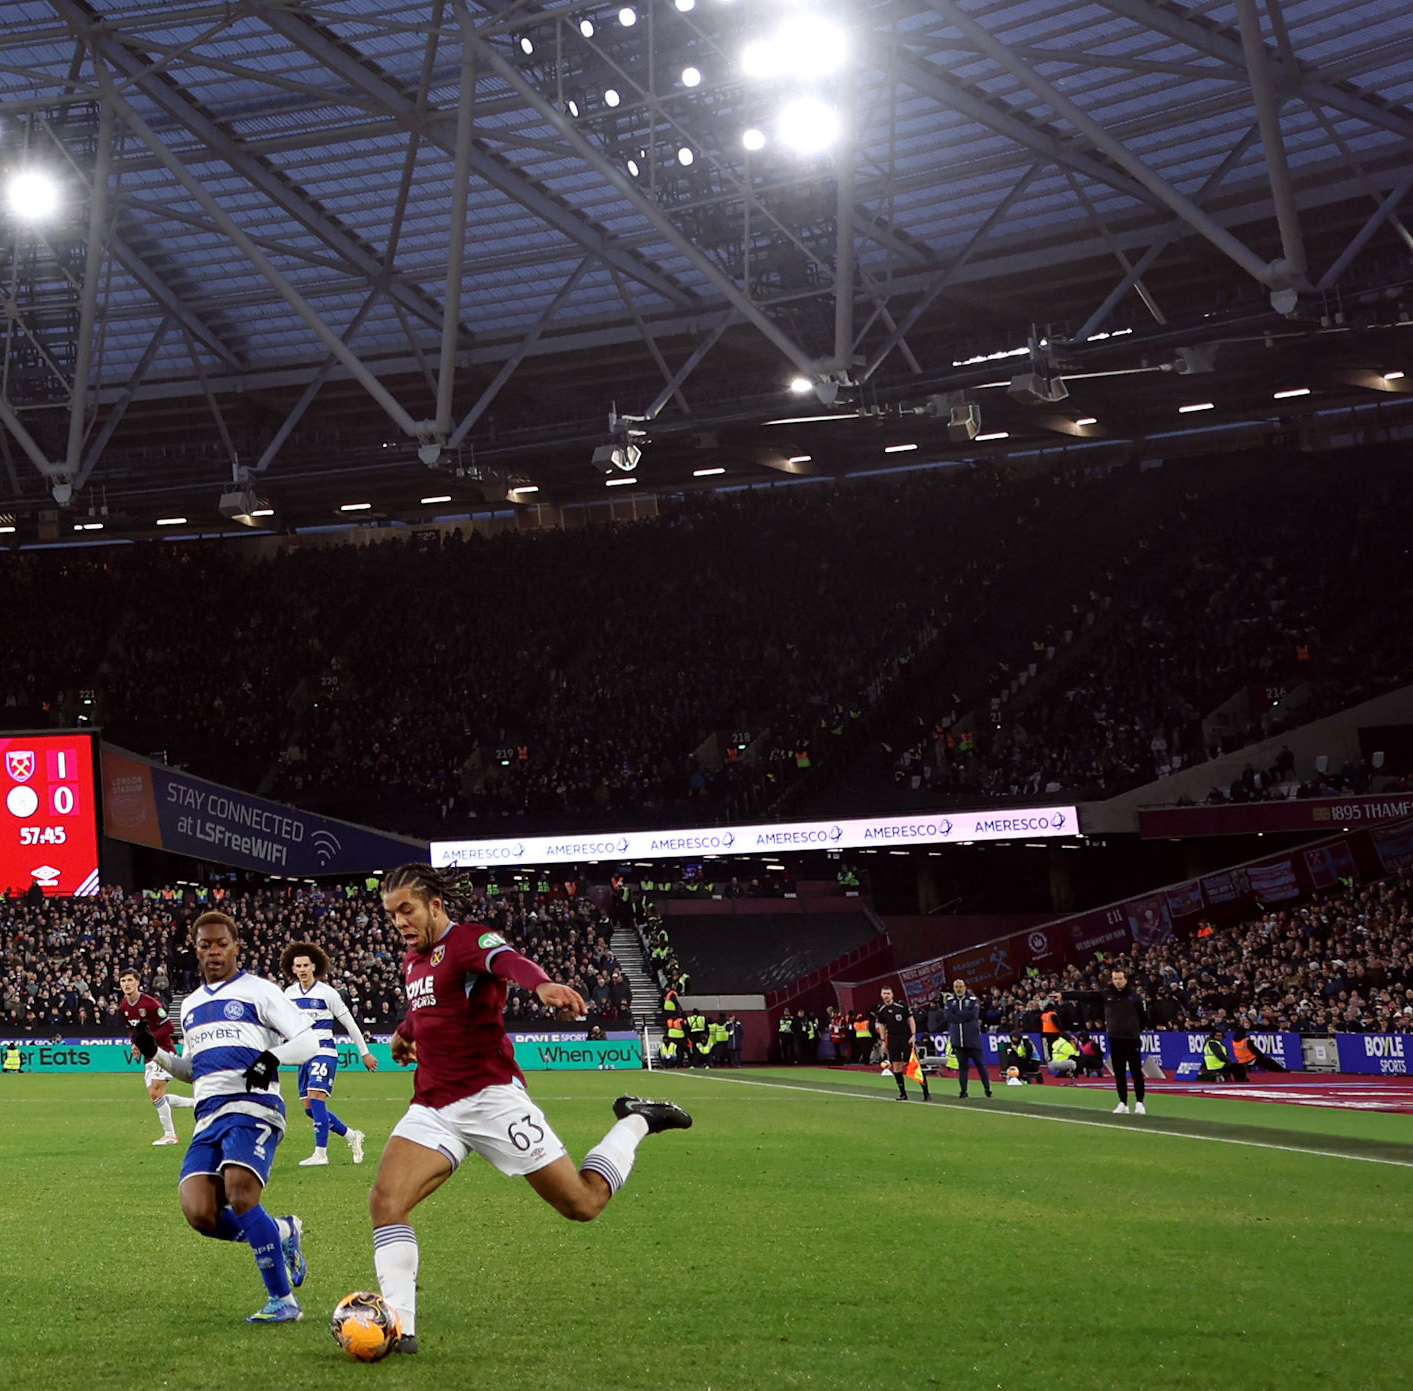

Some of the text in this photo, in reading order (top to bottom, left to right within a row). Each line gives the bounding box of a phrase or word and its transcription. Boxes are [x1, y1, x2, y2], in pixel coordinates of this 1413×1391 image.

[732, 732, 751, 743] 218
[496, 748, 514, 759] 219
[53, 786, 74, 814] 0
[167, 782, 304, 842] STAY CONNECTED
[1331, 801, 1413, 821] 1895 THAME
[177, 815, 194, 836] at
[864, 824, 937, 839] AMERESCO
[974, 817, 1049, 832] AMERESCO
[19, 826, 67, 845] 57:45
[651, 836, 719, 850] AMERESCO
[756, 831, 827, 844] AMERESCO
[442, 848, 510, 861] AMERESCO
[546, 843, 614, 856] AMERESCO
[411, 995, 437, 1012] SPORTS
[515, 1033, 588, 1042] BOYLE SPORT
[1364, 1035, 1405, 1058] BOYLE
[39, 1048, 91, 1066] Eats
[538, 1047, 595, 1063] When
[311, 1062, 328, 1077] 26
[1380, 1058, 1407, 1074] SPORTS
[255, 1123, 272, 1146] 7
[508, 1114, 544, 1151] 63
